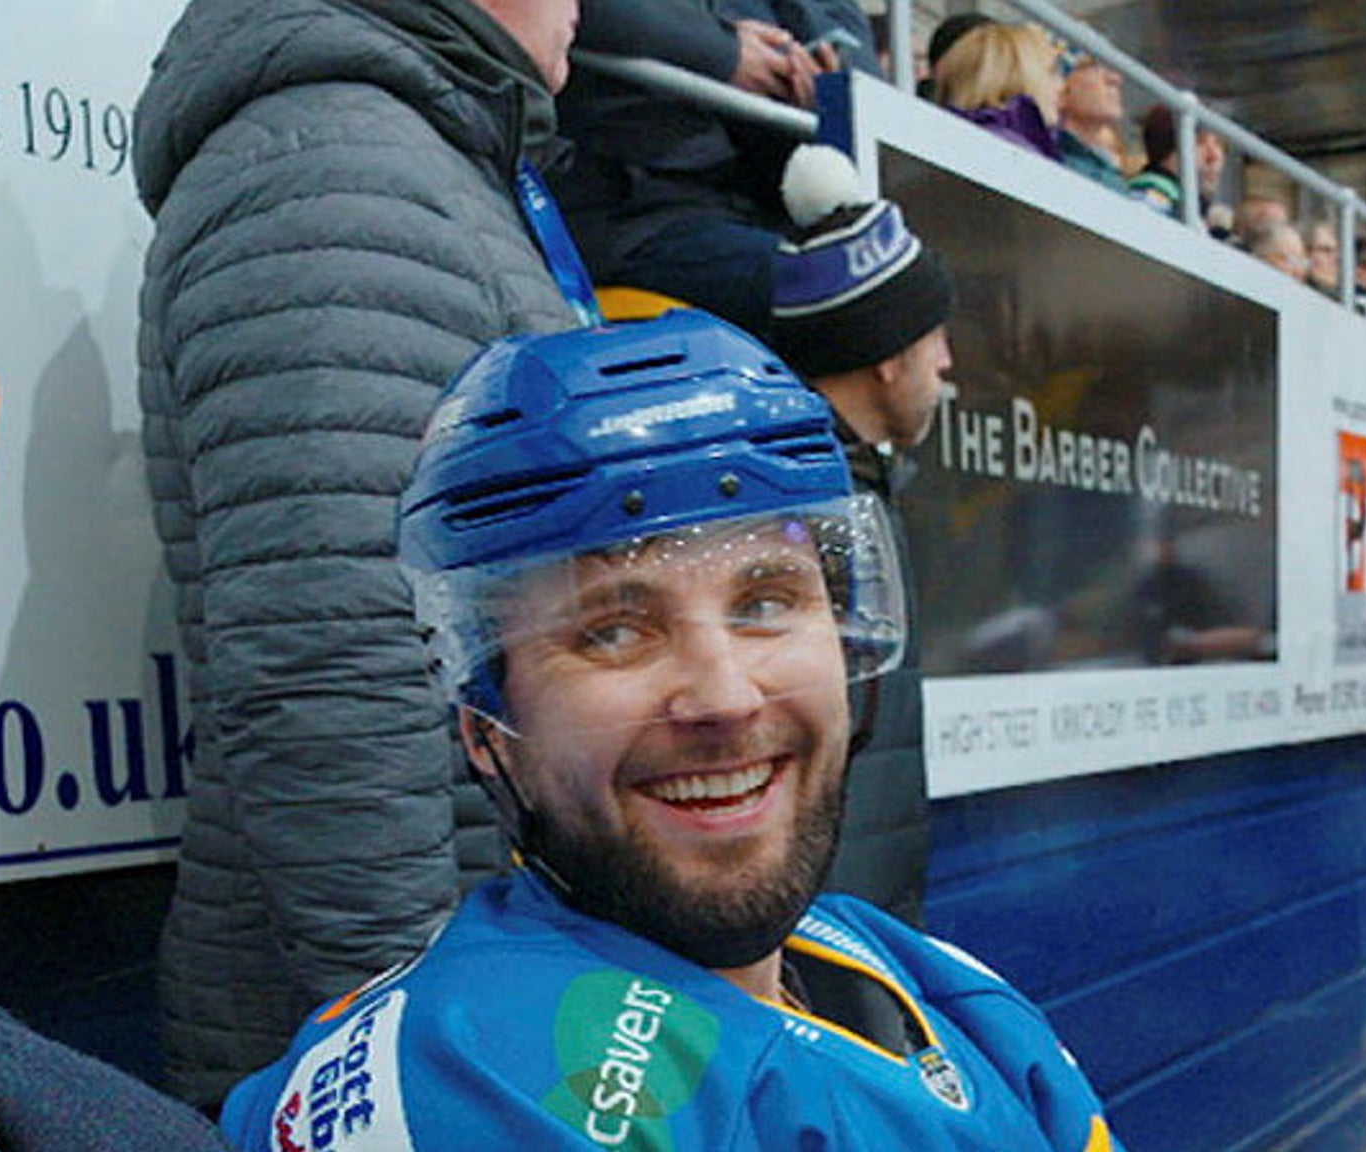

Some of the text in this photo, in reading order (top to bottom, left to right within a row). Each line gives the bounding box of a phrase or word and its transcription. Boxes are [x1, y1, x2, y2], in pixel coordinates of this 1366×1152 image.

[938, 382, 1262, 516] THE BARBER COLLECTIVE
